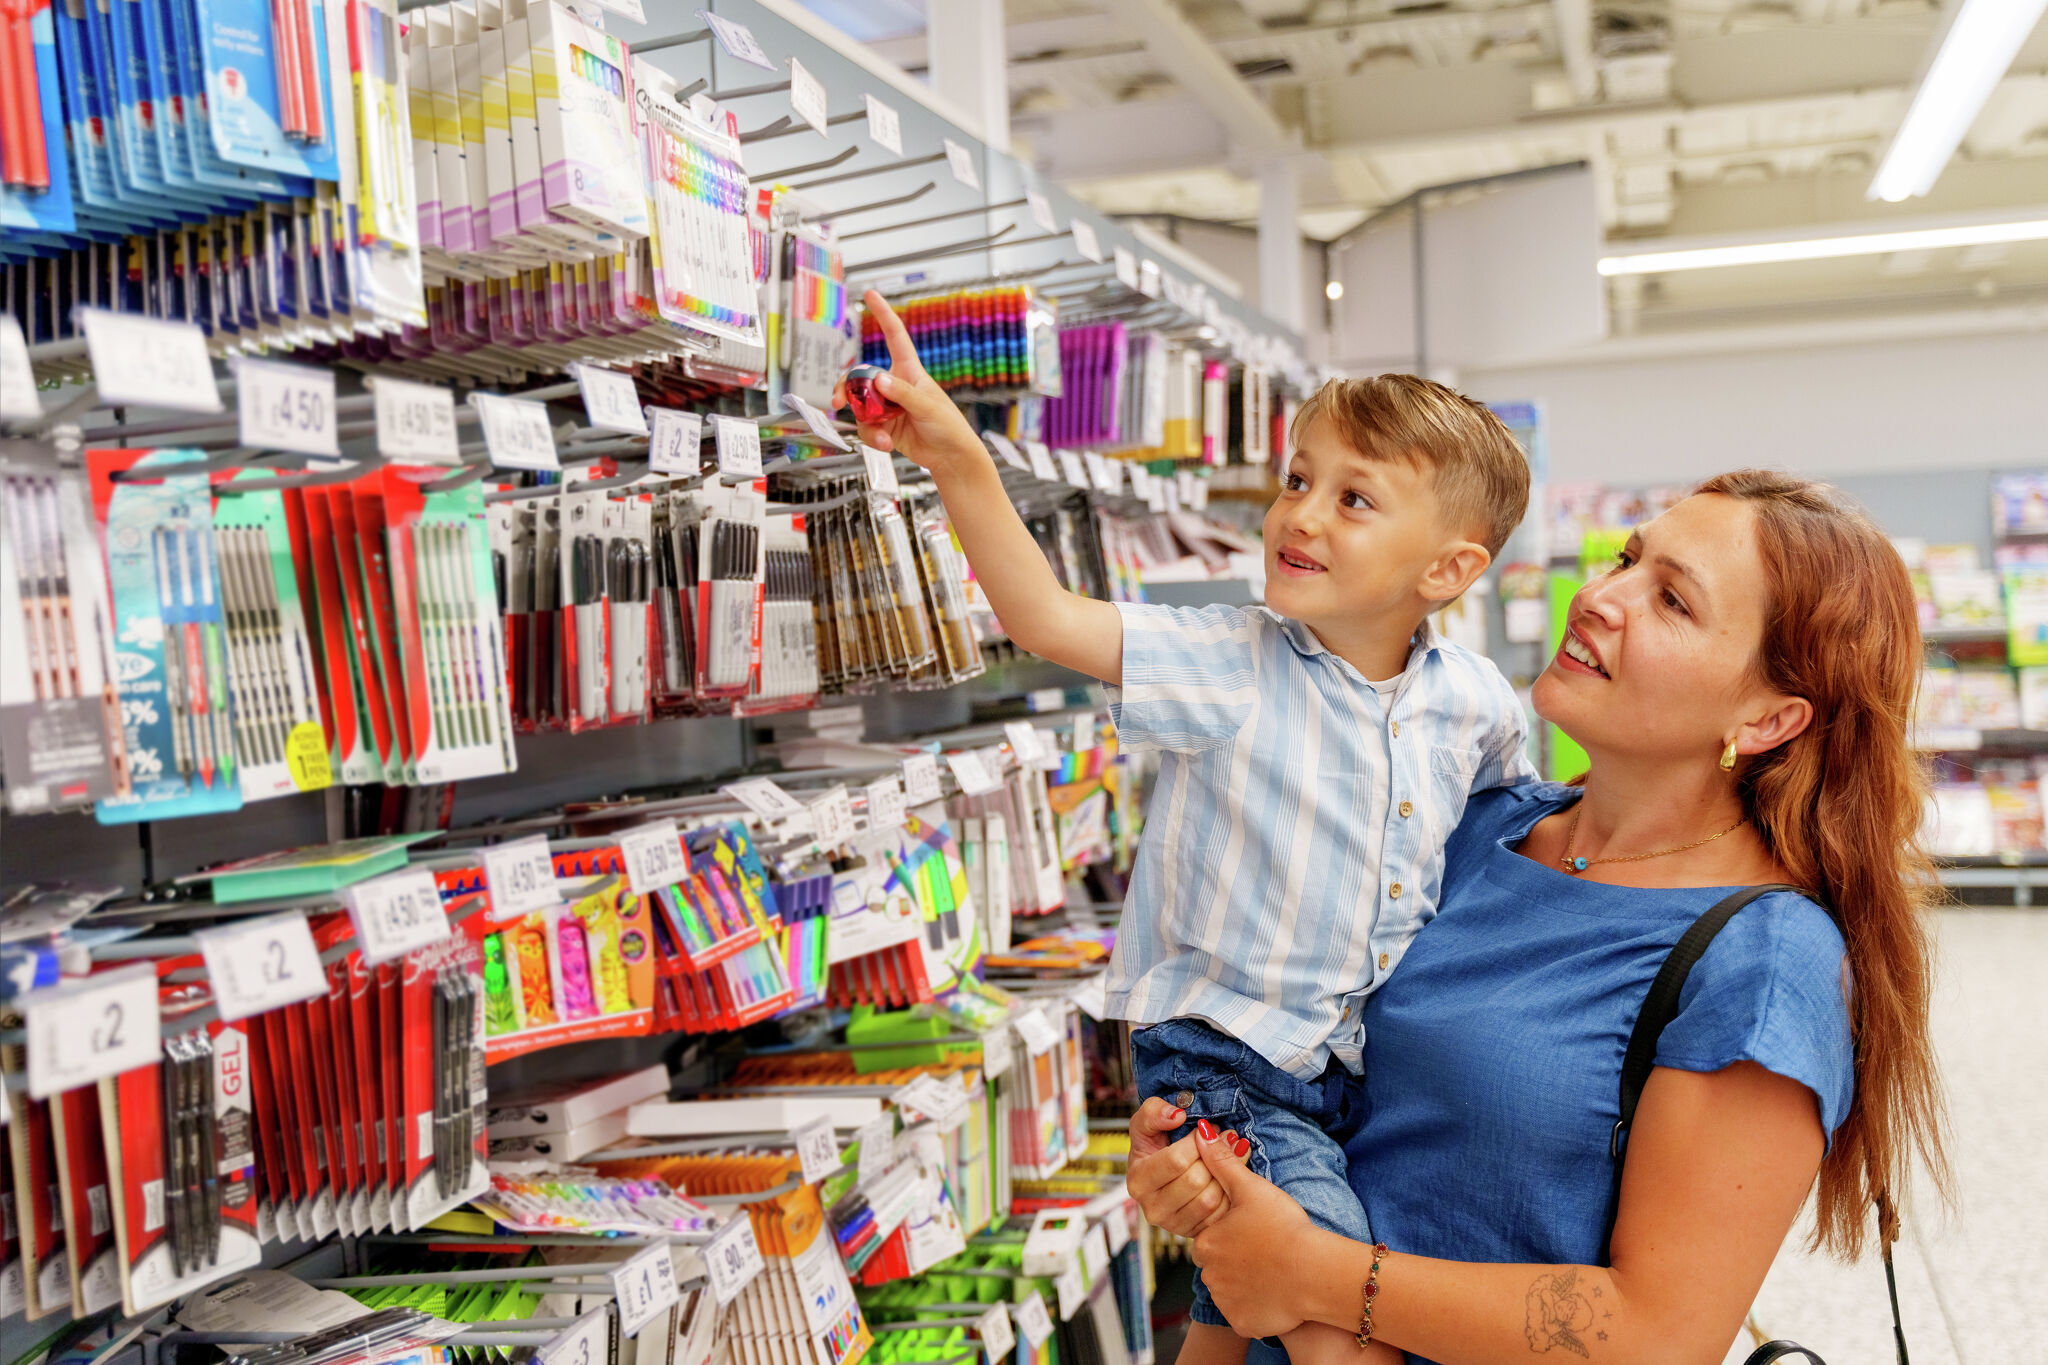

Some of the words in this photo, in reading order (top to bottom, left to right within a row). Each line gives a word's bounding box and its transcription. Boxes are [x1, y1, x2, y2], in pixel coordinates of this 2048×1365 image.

[262, 940, 293, 985] £2
[91, 1001, 126, 1055] £2
[221, 1039, 242, 1097] GEL
